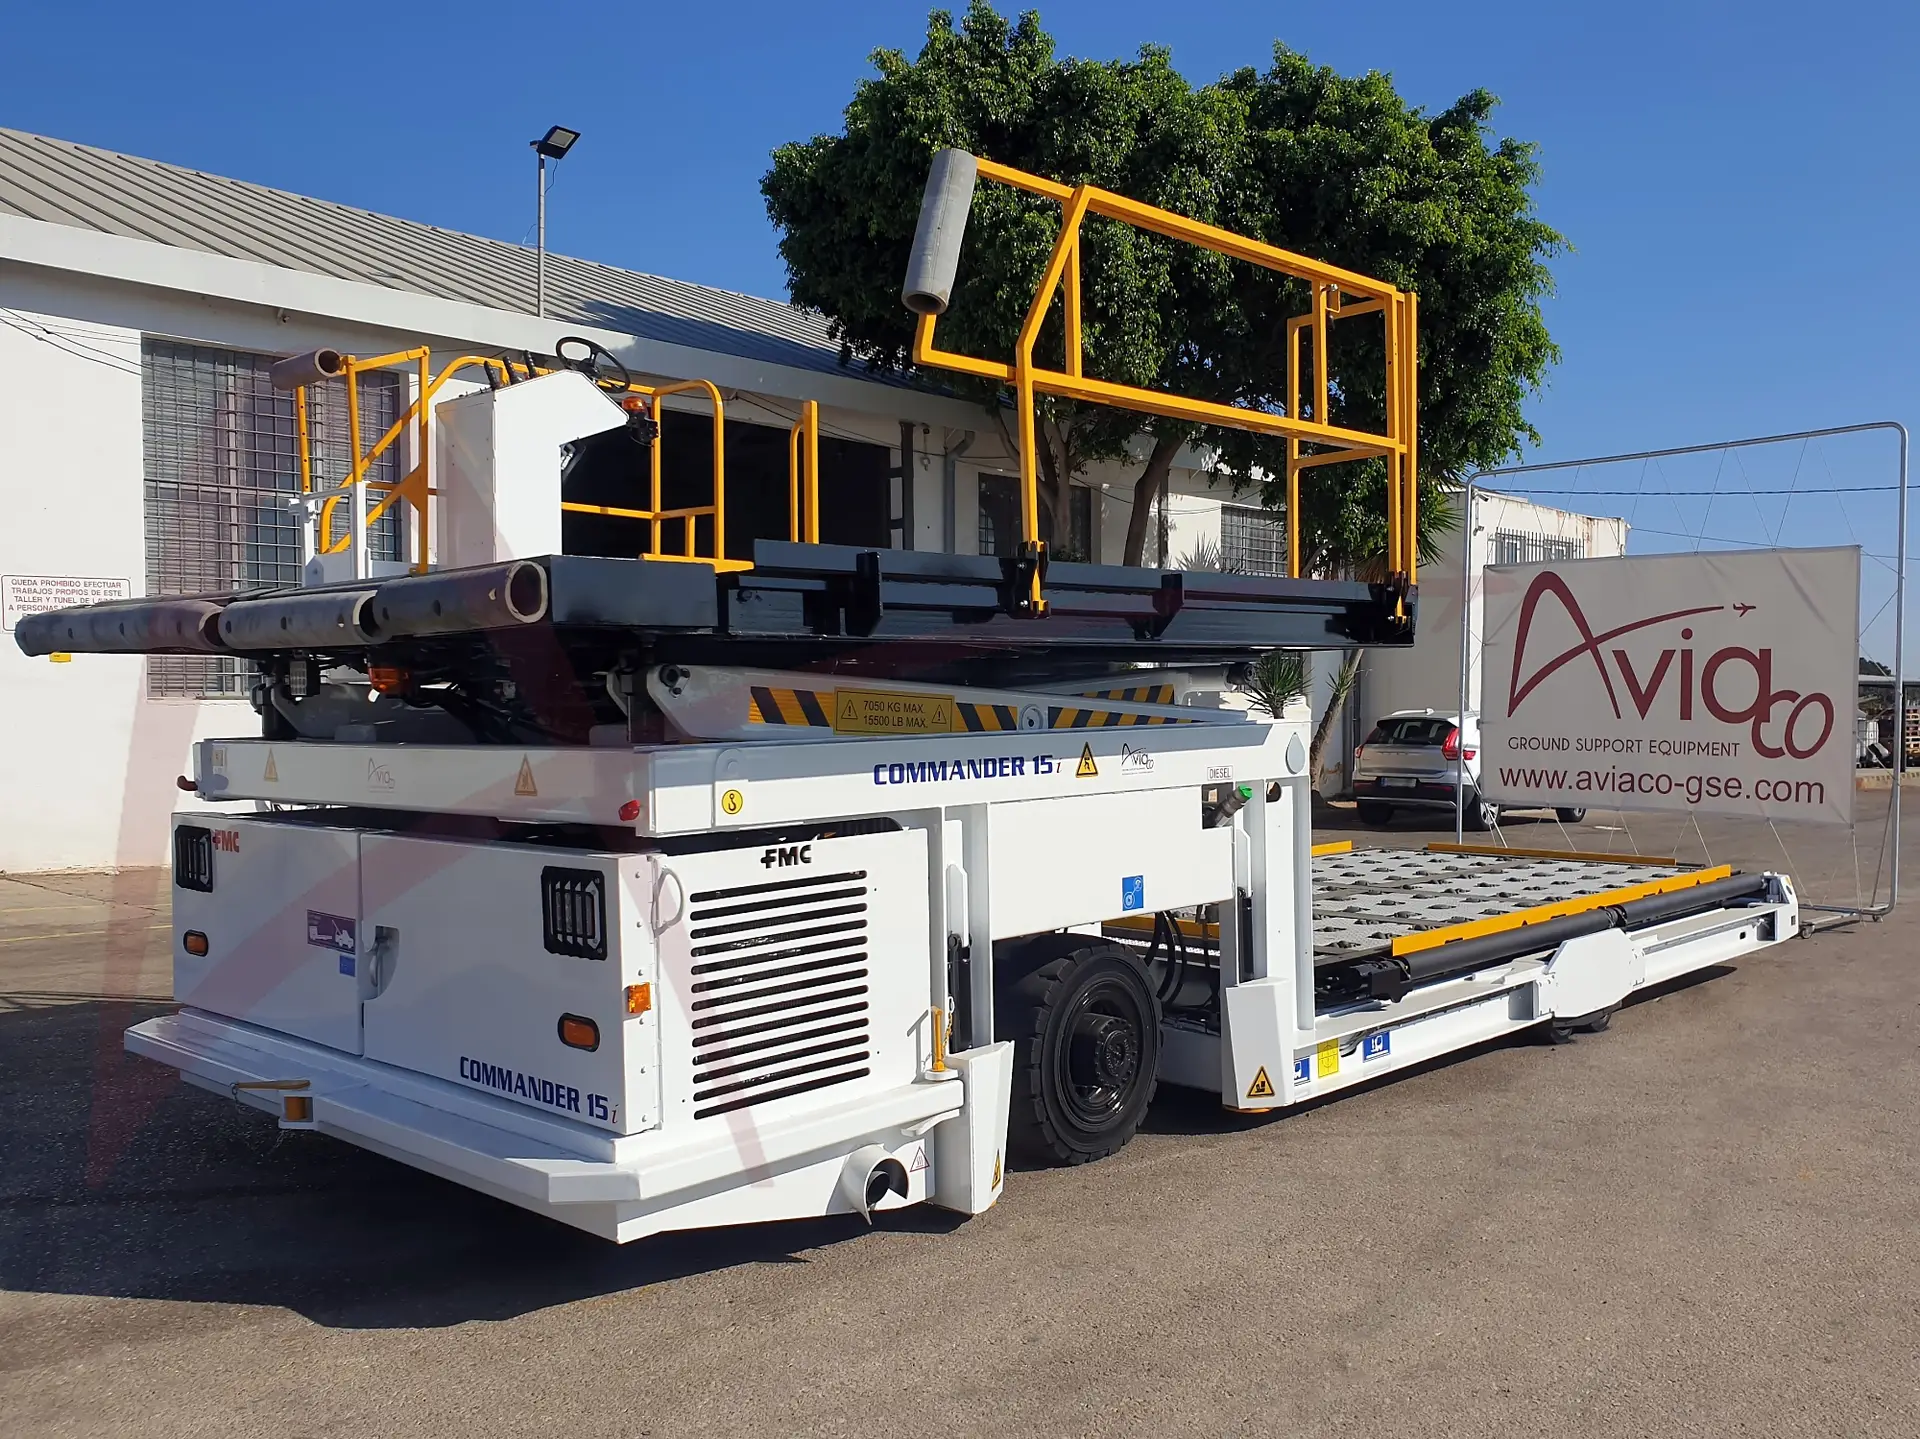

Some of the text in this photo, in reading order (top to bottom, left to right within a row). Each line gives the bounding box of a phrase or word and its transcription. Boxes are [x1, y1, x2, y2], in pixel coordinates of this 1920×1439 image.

[11, 587, 52, 595] TRABAJOS
[55, 588, 88, 596] PROPIOS
[17, 604, 58, 612] PERSONAS
[1507, 571, 1835, 759] Aviaco
[863, 700, 926, 714] 7050 KG MAX.
[863, 715, 928, 729] 15500 LB MAX.
[1508, 736, 1741, 757] GROUND SUPPORT EQUIPMENT
[873, 756, 1025, 785] COMMANDER
[1209, 767, 1232, 779] DIESEL
[1499, 765, 1825, 805] www.aviaco-gse.com
[212, 829, 240, 853] FMC
[760, 844, 812, 869] FMC
[460, 1056, 581, 1114] COMMANDER
